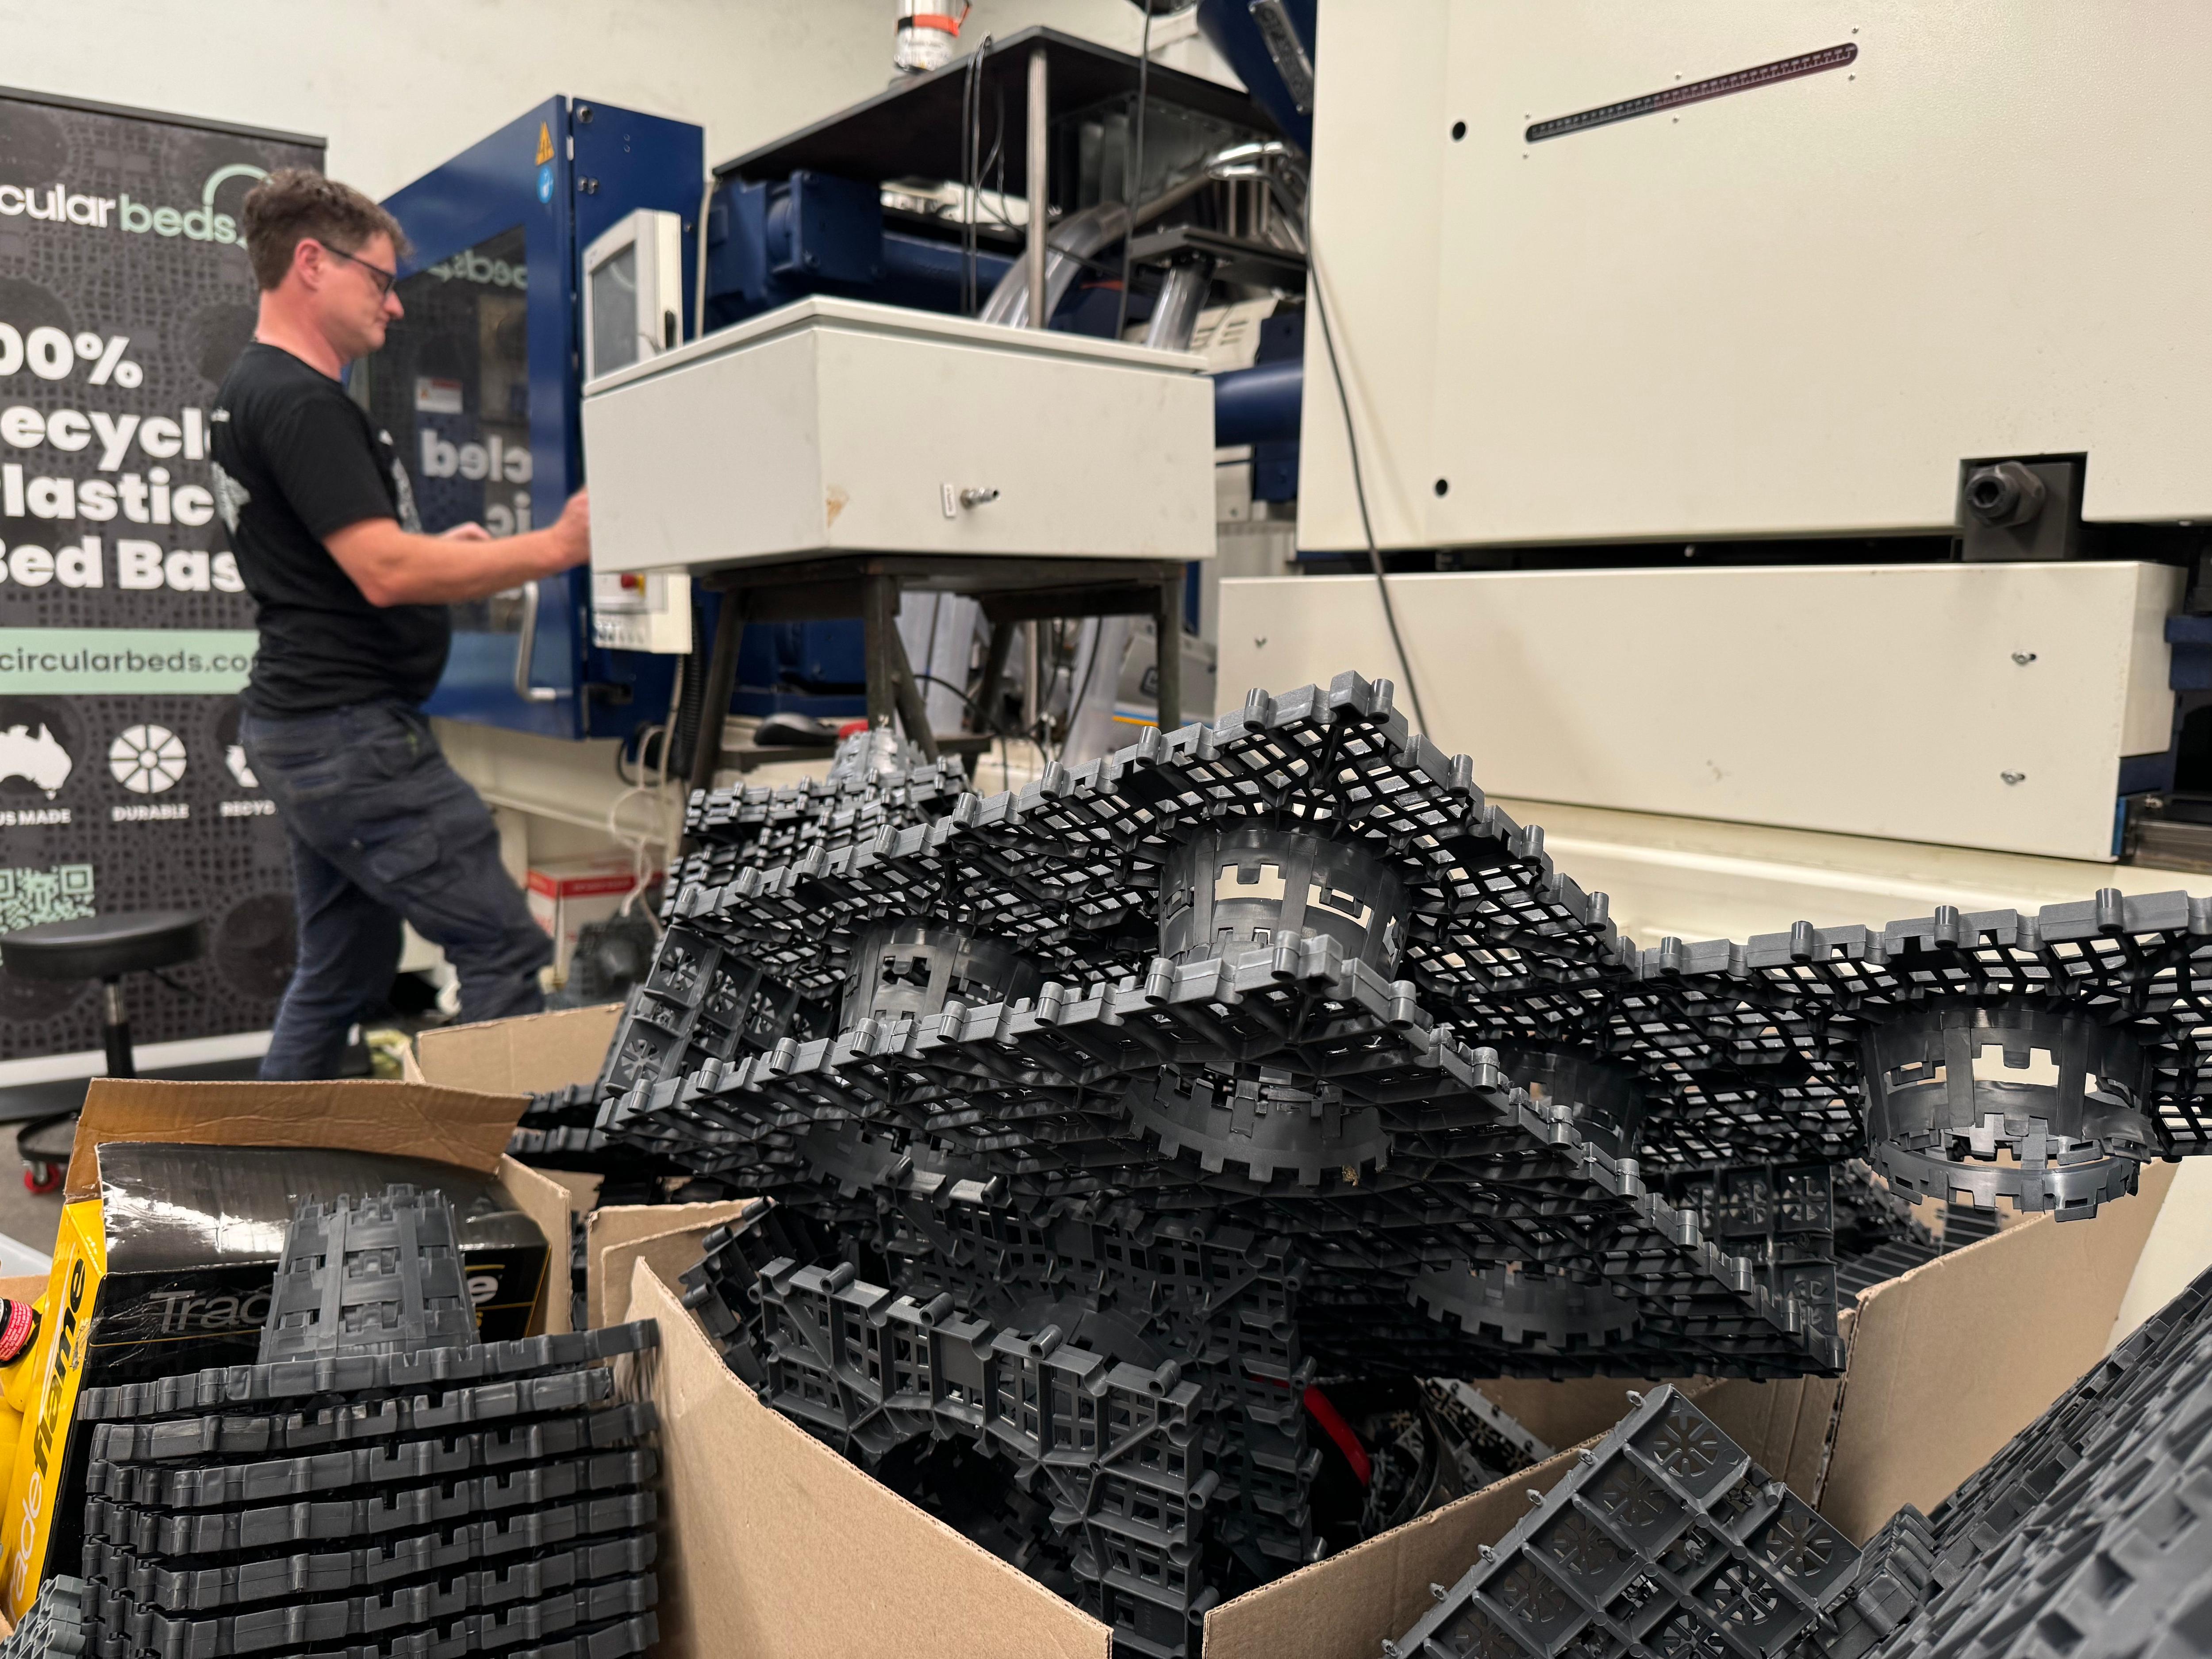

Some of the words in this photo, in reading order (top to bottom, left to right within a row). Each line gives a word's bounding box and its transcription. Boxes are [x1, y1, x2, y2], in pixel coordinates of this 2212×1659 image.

[0, 406, 211, 472] ecycl
[0, 535, 104, 589] ed
[17, 808, 72, 826] MADE
[112, 802, 190, 822] DURABLE
